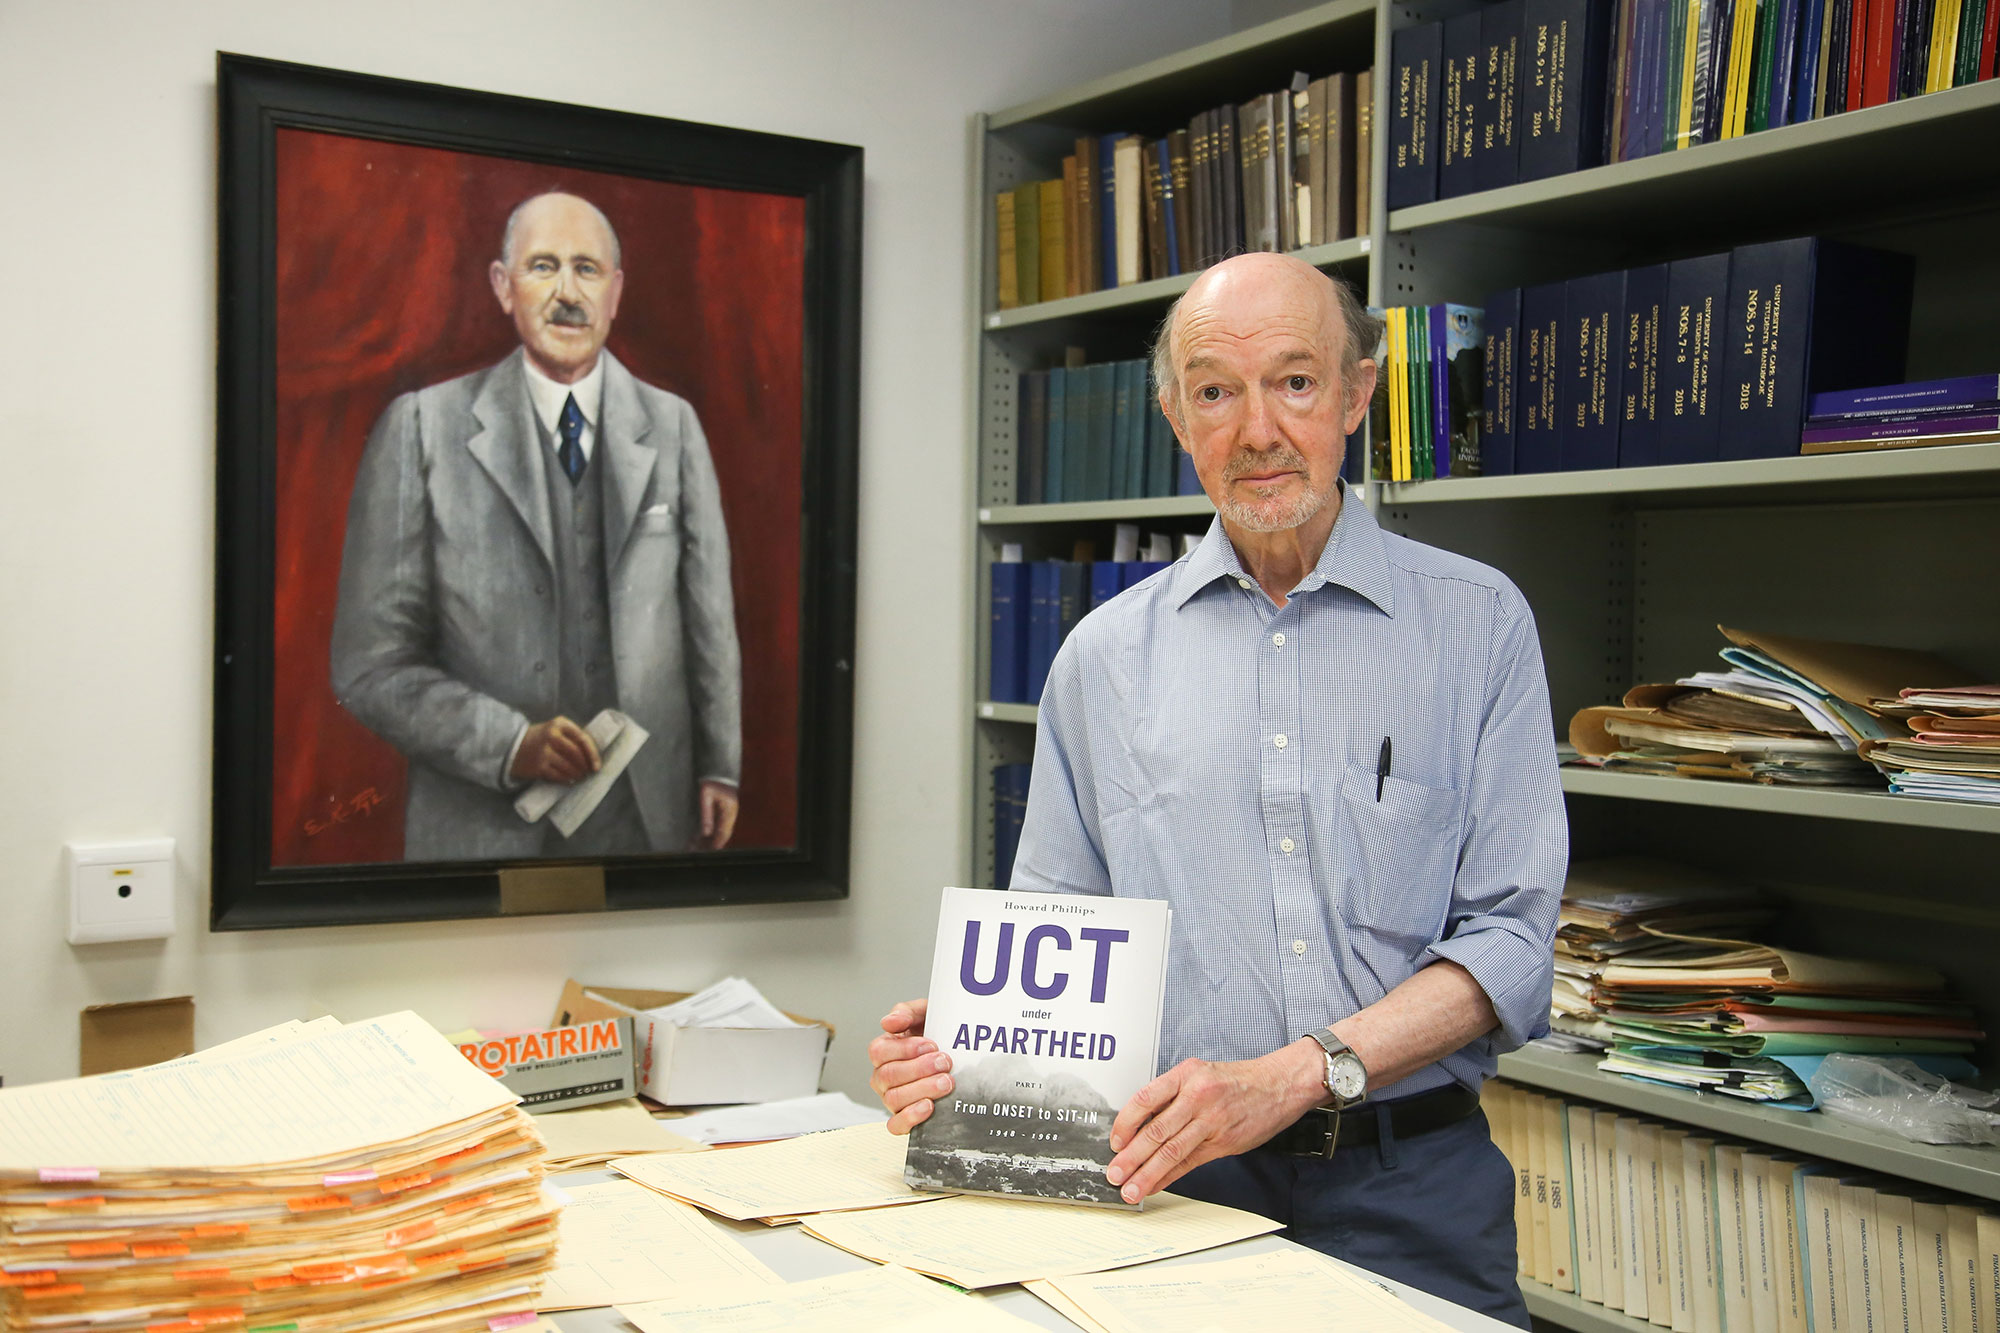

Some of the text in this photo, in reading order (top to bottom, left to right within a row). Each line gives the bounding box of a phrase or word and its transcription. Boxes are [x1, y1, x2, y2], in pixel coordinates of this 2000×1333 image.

[1537, 25, 1548, 57] NOS.
[1489, 45, 1499, 77] NOS.
[1485, 123, 1494, 149] 2016
[1533, 111, 1542, 137] 2016
[1746, 288, 1759, 323] NOS.
[1772, 284, 1782, 337] UNIVERSITY
[1580, 317, 1590, 349] NOS.
[1629, 312, 1640, 345] NOS.
[1679, 305, 1690, 338] NOS.
[1703, 296, 1712, 348] UNIVERSITY
[1530, 328, 1539, 359] NOS.
[1702, 350, 1709, 361] OF
[1758, 299, 1772, 396] STUDENTS HANDBOOK
[1771, 340, 1778, 352] OF
[1626, 394, 1636, 421] 2018
[1674, 389, 1685, 416] 2018
[1740, 382, 1751, 411] 2018
[1766, 378, 1775, 408] TOWN
[1528, 405, 1537, 430] 2017
[1577, 402, 1586, 428] 2017
[1004, 901, 1096, 917] Howard Phillips
[960, 920, 1130, 1004] UCT
[1021, 1009, 1052, 1020] under
[460, 1021, 619, 1078] ROTATRIM
[952, 1023, 1117, 1062] APARTHEID
[576, 1082, 617, 1095] COPIER
[1015, 1081, 1036, 1089] PART
[954, 1100, 1099, 1124] From ONSET to SIT-IN
[989, 1129, 1016, 1138] 1948
[1031, 1133, 1059, 1142] 1968
[1521, 1168, 1530, 1197] 1985
[1536, 1174, 1546, 1204] 1985
[1551, 1180, 1561, 1209] 1985
